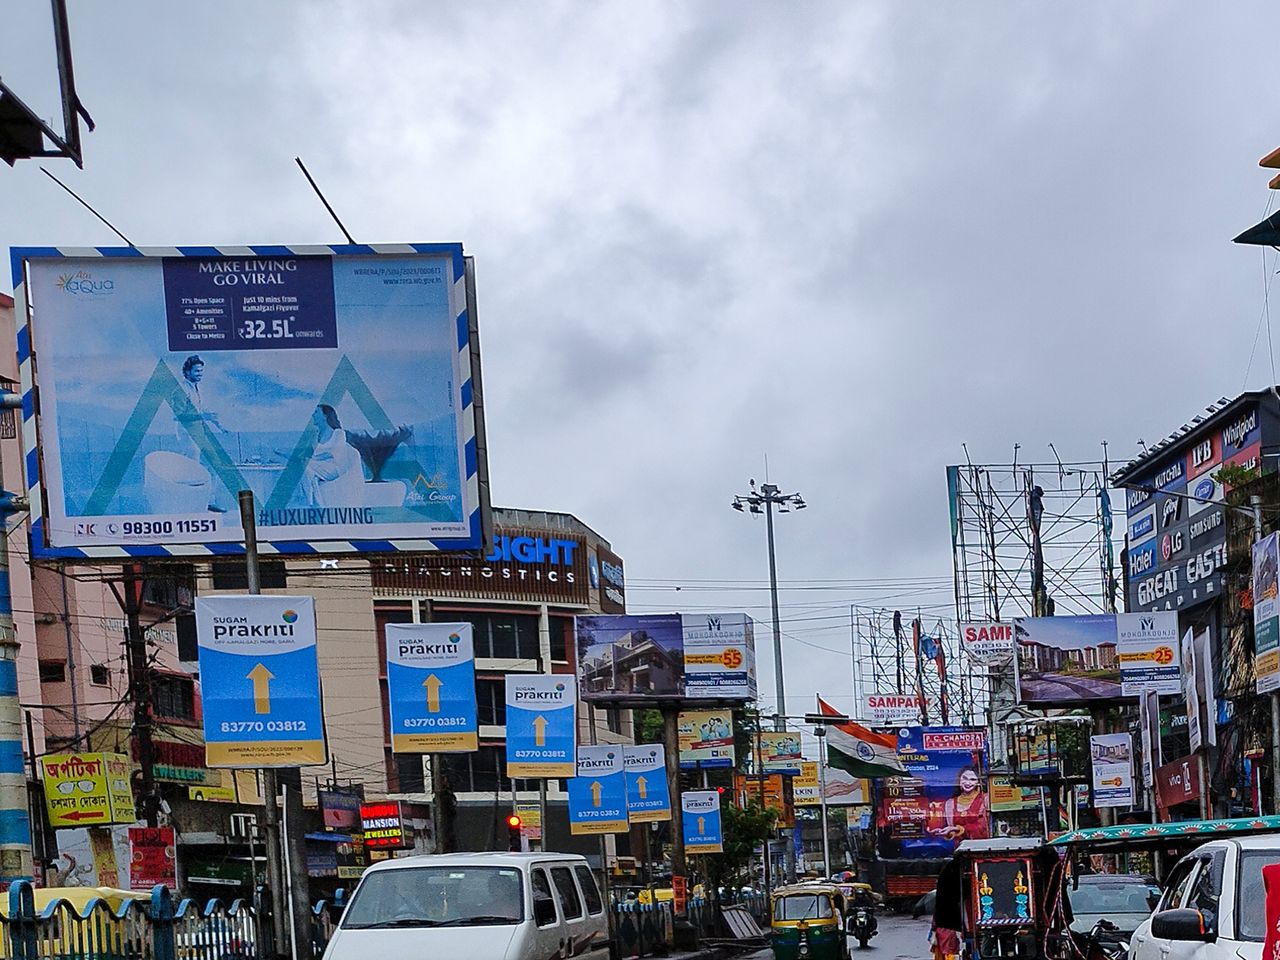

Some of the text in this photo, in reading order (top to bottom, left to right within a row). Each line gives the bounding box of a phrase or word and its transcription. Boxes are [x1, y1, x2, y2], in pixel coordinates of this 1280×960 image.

[199, 259, 297, 273] MAKE LIVING
[213, 273, 285, 286] GO VIRAL
[1192, 439, 1212, 468] IFB
[259, 507, 374, 527] #LUXURYLIVING
[123, 521, 172, 535] 98300
[176, 519, 217, 533] 11551
[1190, 510, 1222, 539] SAMSUNG
[1171, 531, 1182, 553] LG
[1130, 548, 1152, 576] Haier
[1138, 565, 1180, 606] GREAT
[213, 624, 294, 639] prakriti
[399, 644, 458, 656] prakriti
[1155, 650, 1173, 662] 25
[722, 652, 741, 666] 55
[515, 691, 562, 701] prakriti
[221, 720, 306, 732] 83770 03812
[404, 717, 466, 727] 83770 03812
[624, 757, 656, 765] rakriti
[152, 764, 206, 782] EWELLERS
[1169, 774, 1181, 787] vivo
[51, 795, 107, 809] চশমার দোকান
[363, 818, 399, 829] MANSION
[364, 829, 402, 839] JEWELLERS
